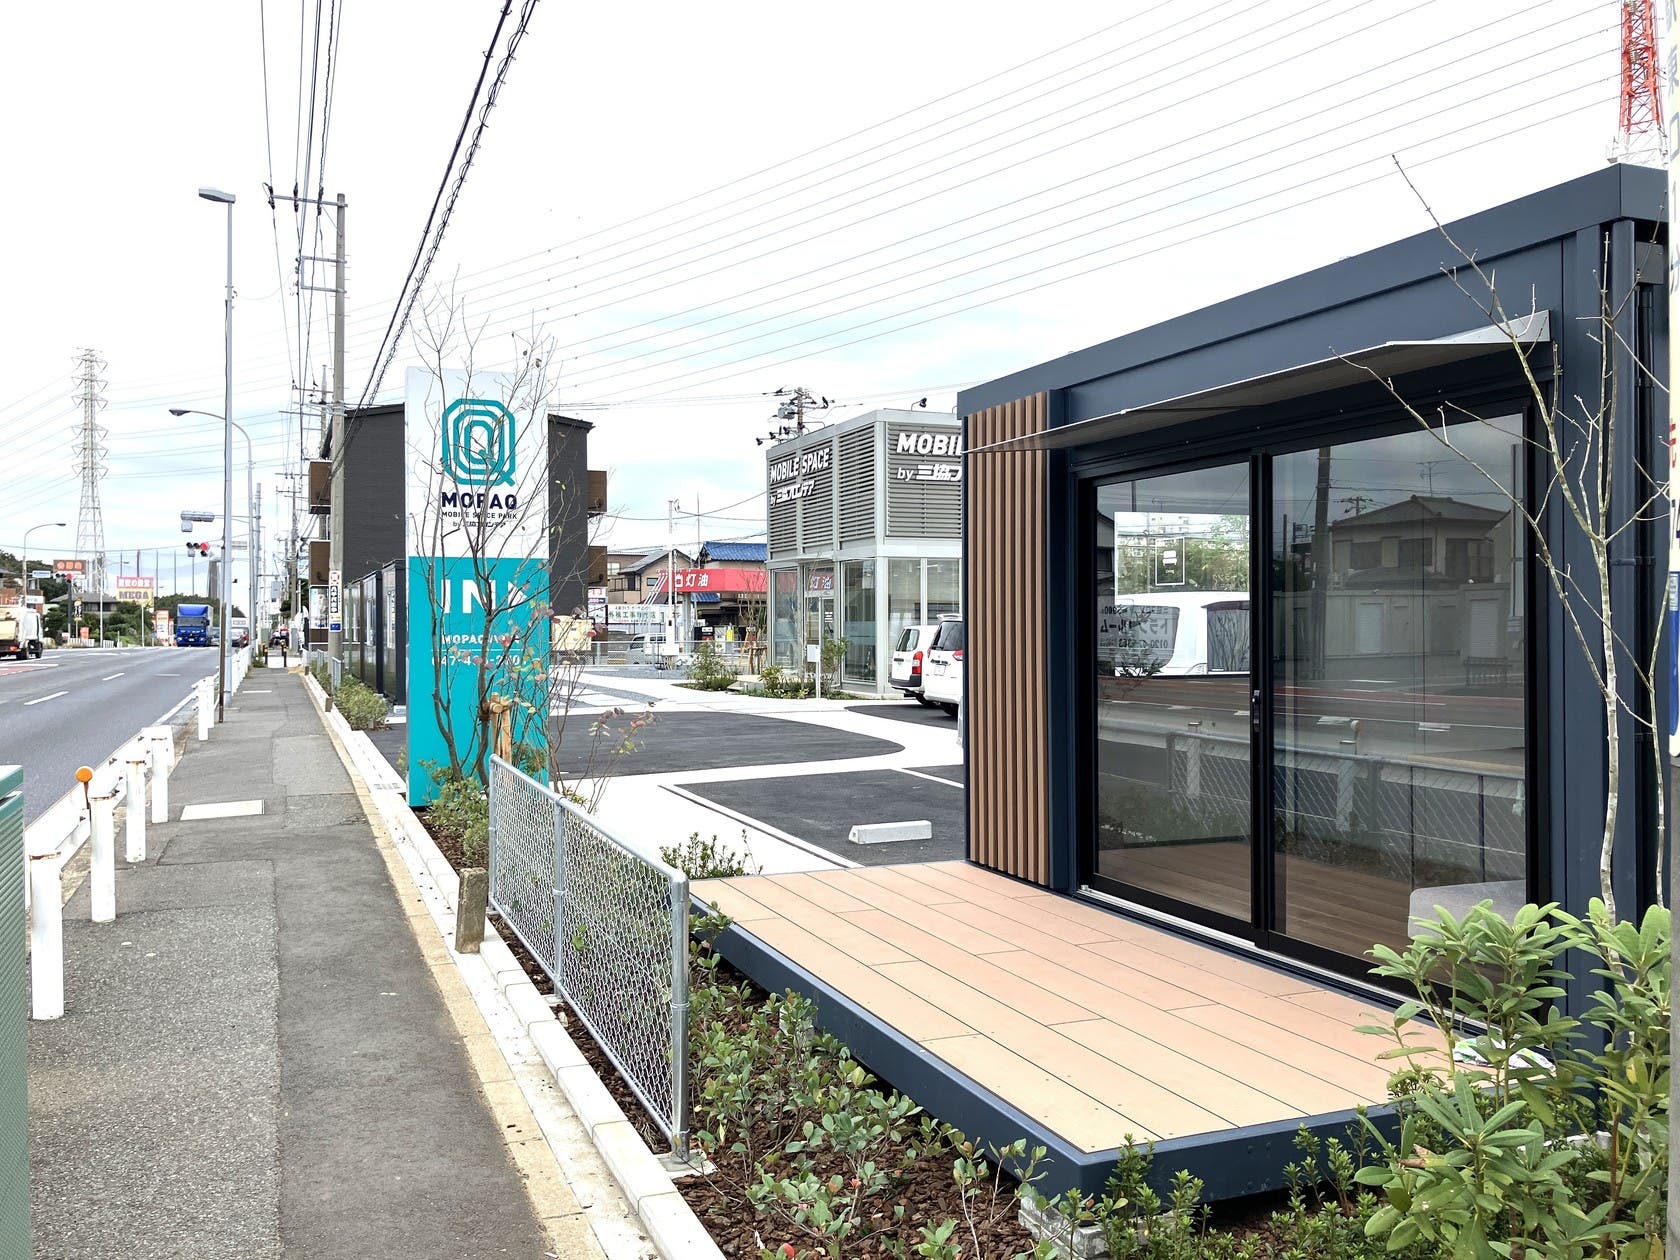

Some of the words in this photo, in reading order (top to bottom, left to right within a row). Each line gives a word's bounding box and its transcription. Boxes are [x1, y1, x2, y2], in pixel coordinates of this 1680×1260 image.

[771, 457, 800, 483] MOBILE
[801, 448, 829, 474] SPACE
[897, 467, 914, 482] by
[441, 491, 518, 510] MOPAQ
[119, 591, 150, 599] MEGA
[441, 579, 496, 614] IN
